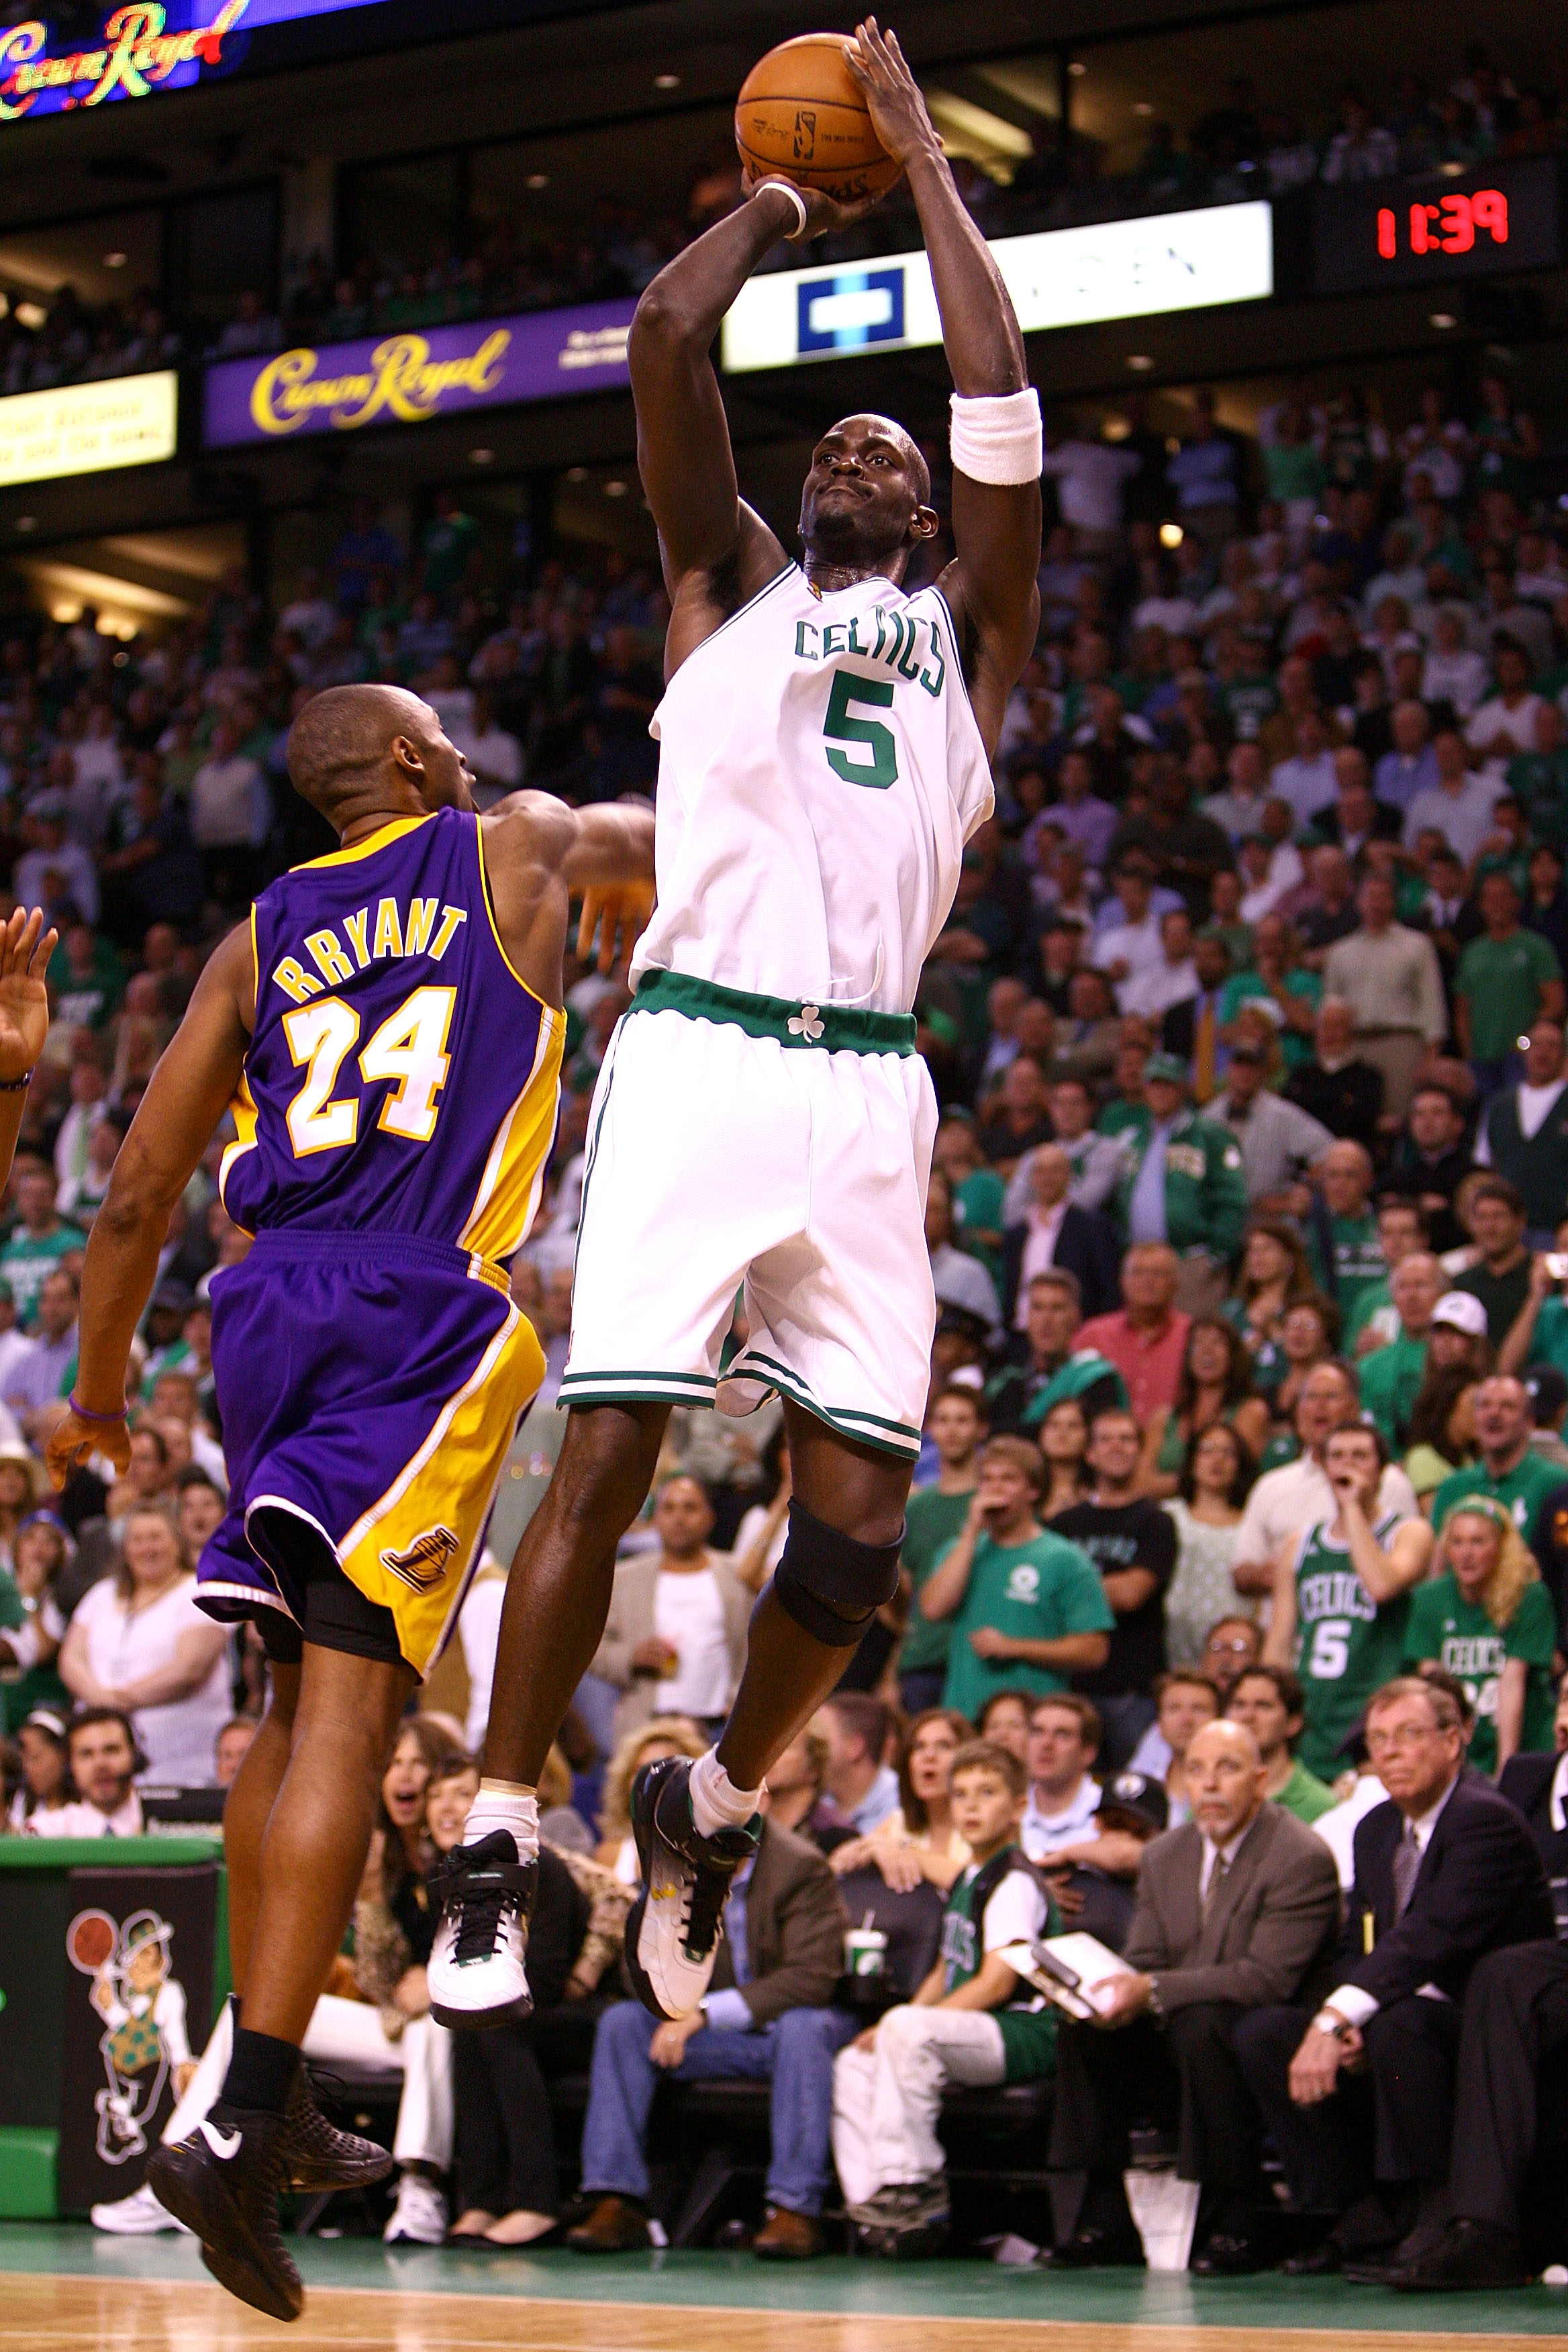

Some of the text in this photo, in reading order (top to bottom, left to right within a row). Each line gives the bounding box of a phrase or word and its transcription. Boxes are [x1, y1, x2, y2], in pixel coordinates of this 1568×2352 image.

[1378, 189, 1508, 259] 11:39
[251, 348, 377, 434] Crown
[331, 329, 511, 430] Royal
[795, 604, 945, 697] CELTICS
[823, 669, 898, 789] 5
[282, 986, 457, 1159] 24
[1310, 1620, 1352, 1679] 5
